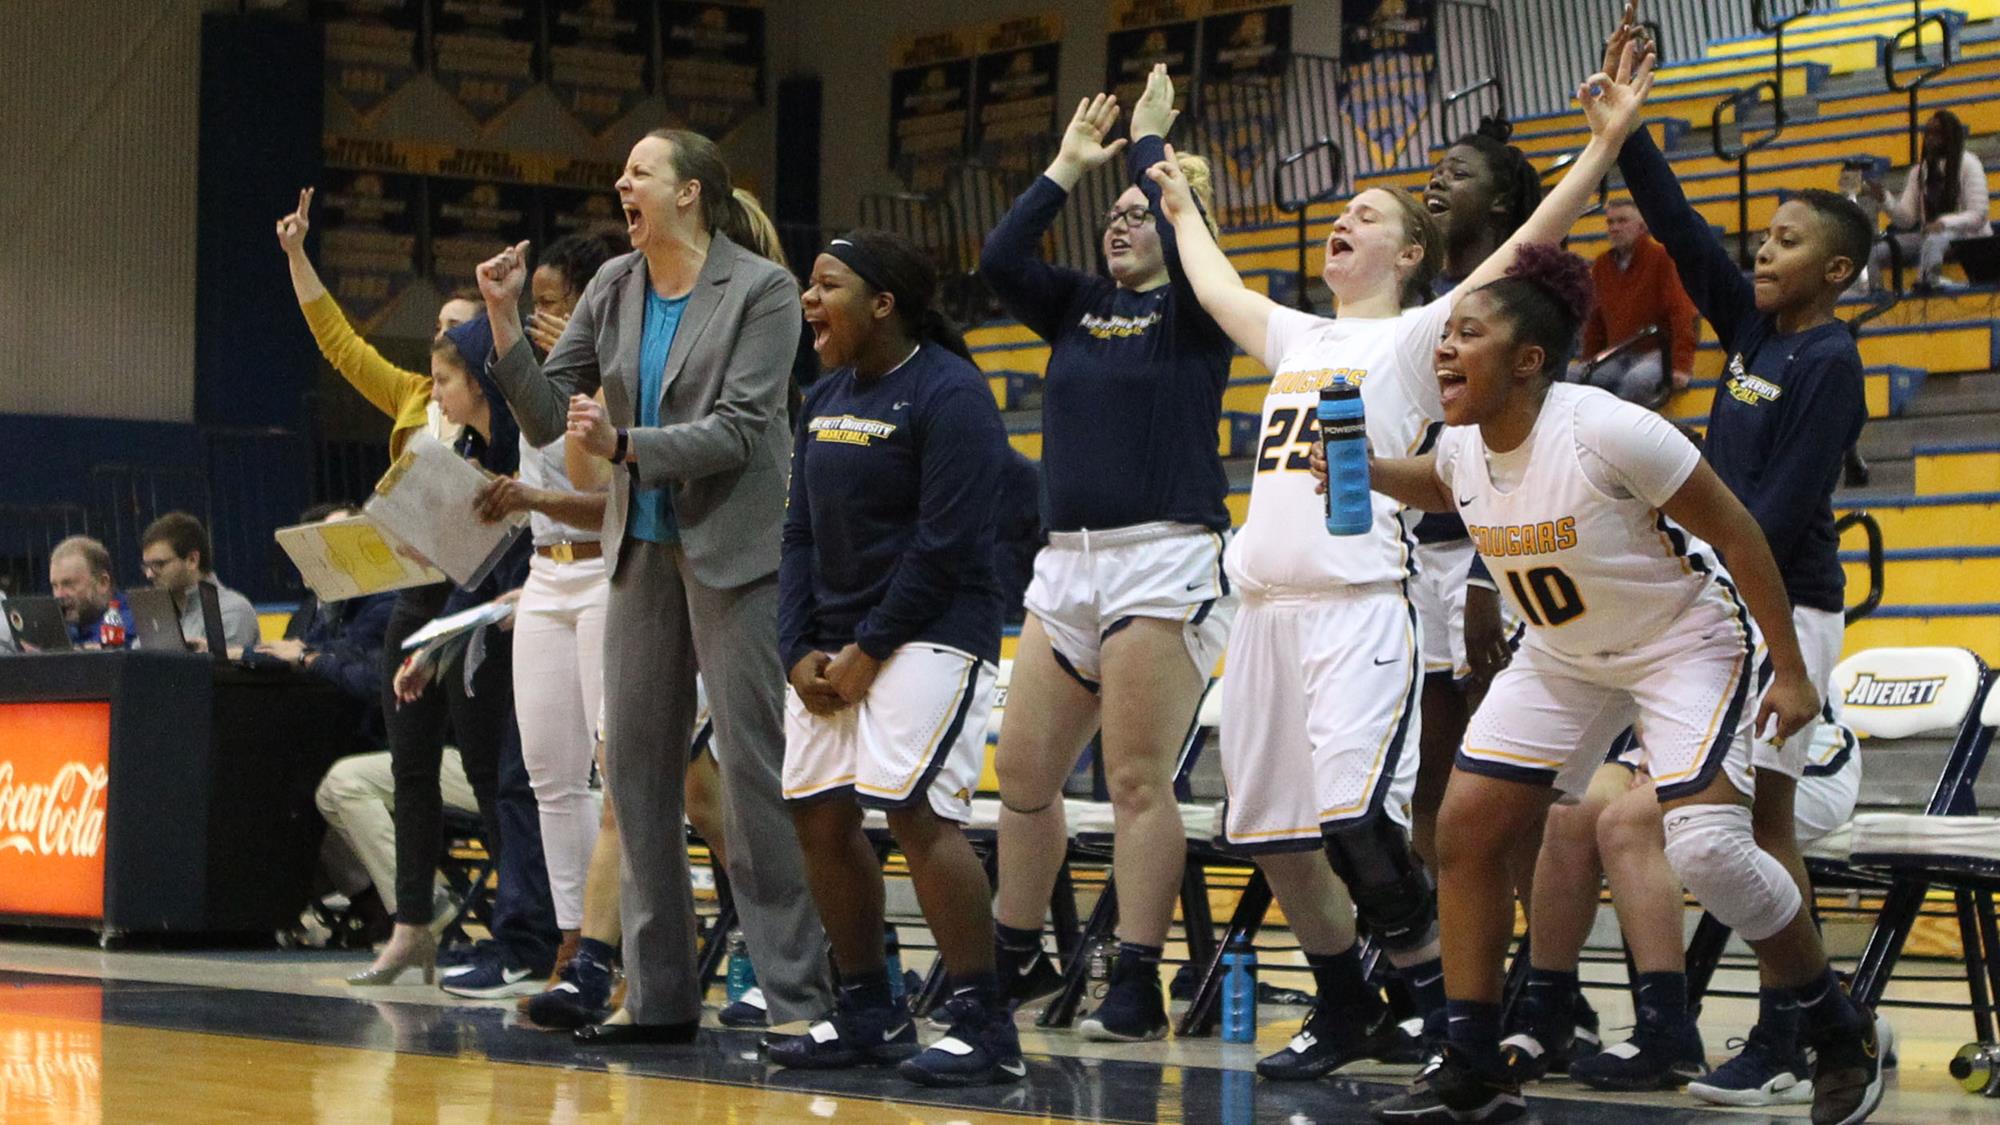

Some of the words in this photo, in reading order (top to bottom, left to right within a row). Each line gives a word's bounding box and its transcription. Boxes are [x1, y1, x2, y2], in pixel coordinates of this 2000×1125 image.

[1269, 368, 1367, 394] OUGAS
[1258, 406, 1320, 474] 25
[1506, 566, 1586, 627] 10
[1845, 673, 1947, 706] AVERETT
